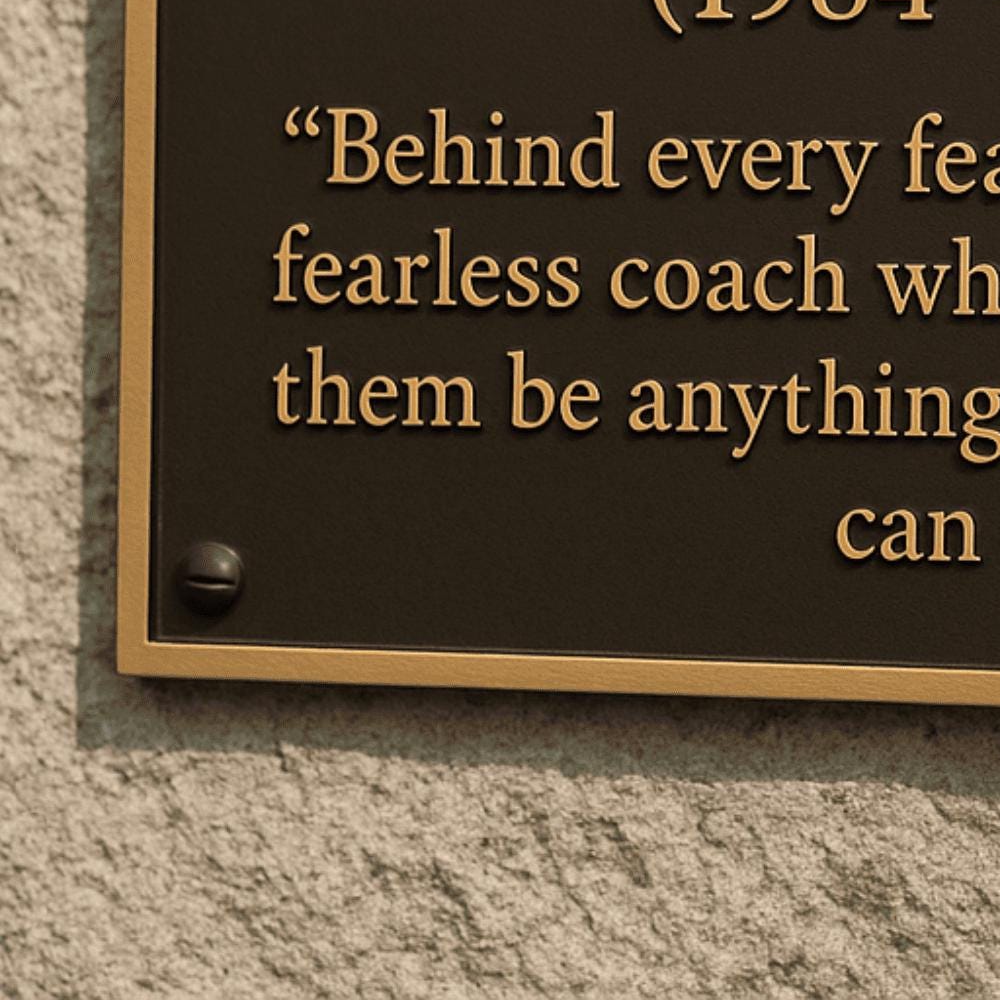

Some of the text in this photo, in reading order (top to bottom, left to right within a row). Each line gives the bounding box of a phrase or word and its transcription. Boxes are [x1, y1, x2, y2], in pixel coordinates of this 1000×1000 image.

[284, 105, 621, 189] “Behind
[647, 136, 879, 217] every
[271, 222, 581, 309] fearless
[609, 233, 850, 312] coach
[271, 344, 482, 428] them
[505, 349, 602, 432] be
[835, 507, 981, 563] can
